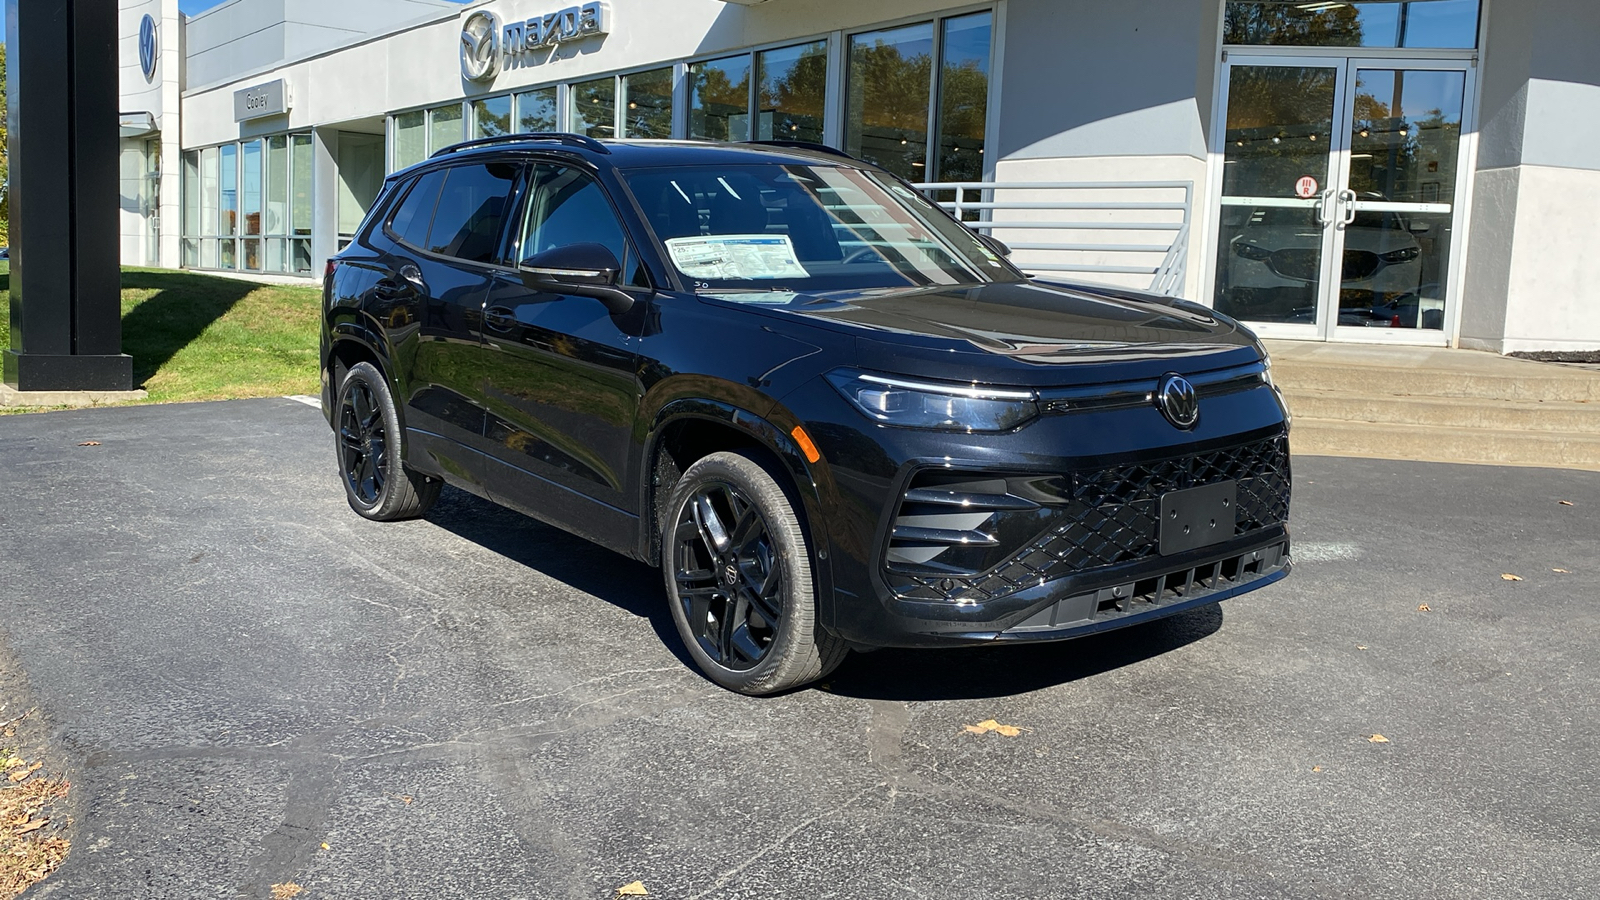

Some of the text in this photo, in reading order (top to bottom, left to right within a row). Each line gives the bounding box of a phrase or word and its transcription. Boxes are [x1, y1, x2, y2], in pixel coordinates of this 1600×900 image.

[503, 1, 604, 56] mazda
[246, 89, 269, 111] Cooley
[1303, 187, 1309, 195] R
